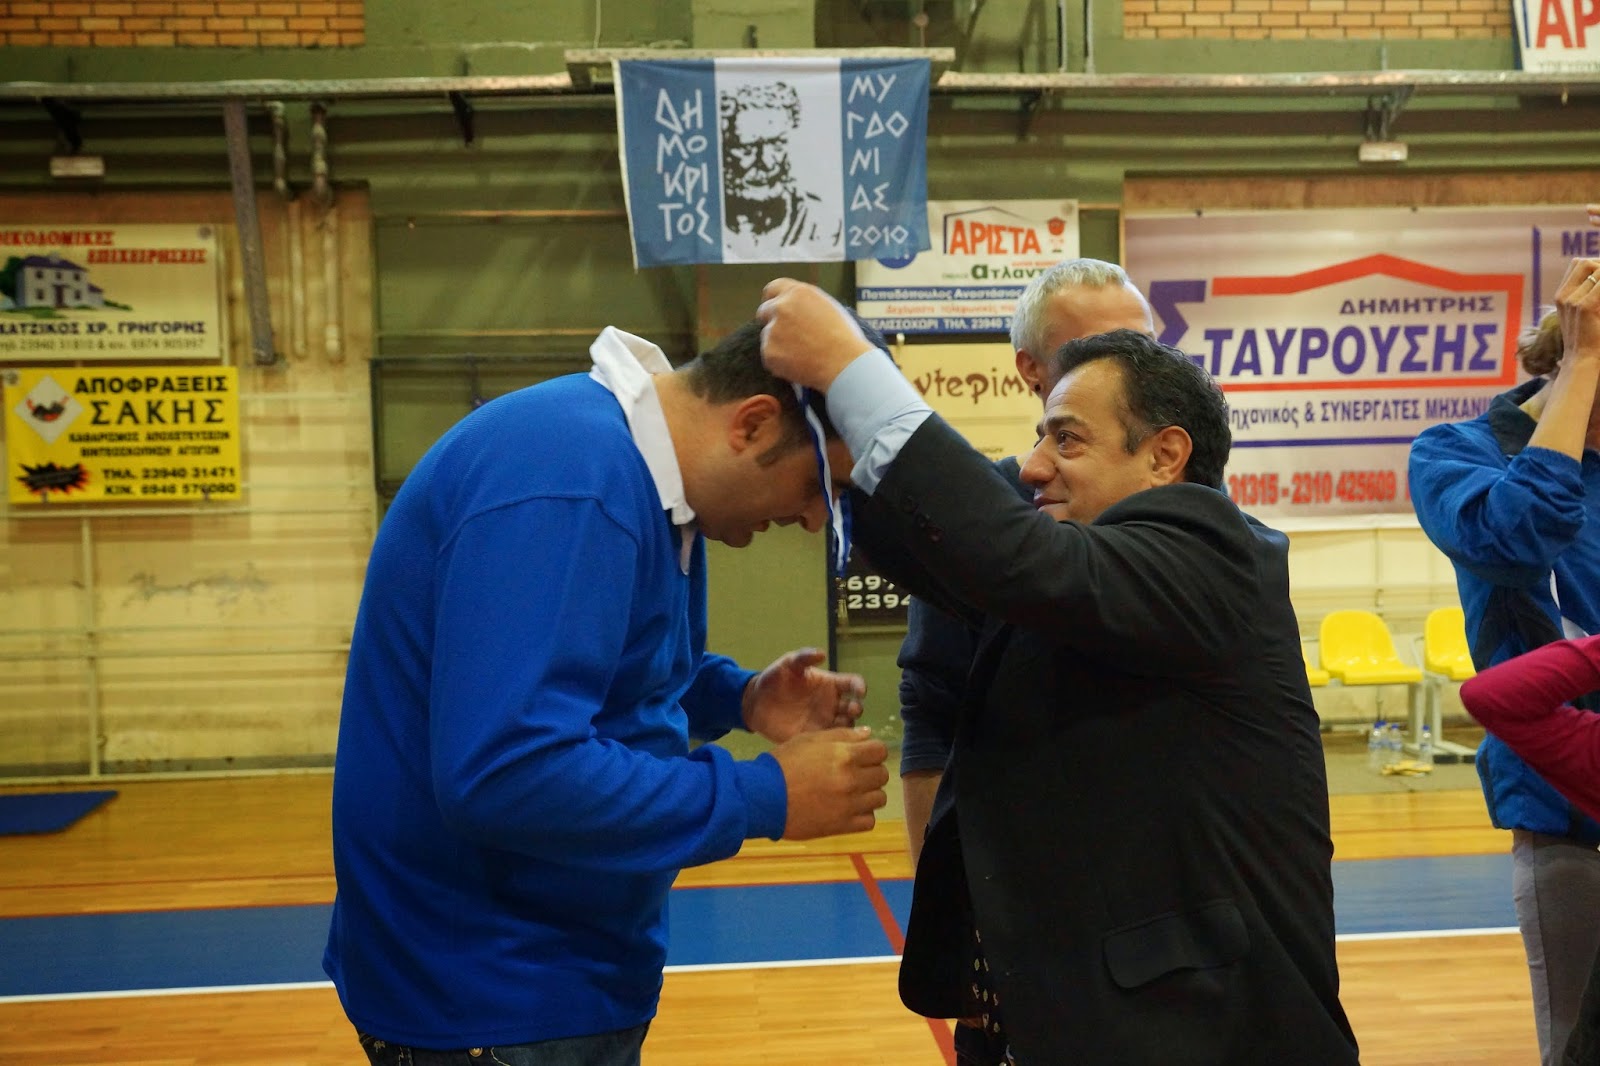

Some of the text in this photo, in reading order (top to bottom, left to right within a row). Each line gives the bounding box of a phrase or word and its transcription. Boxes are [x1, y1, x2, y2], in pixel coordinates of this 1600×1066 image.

[850, 225, 909, 247] 2010
[949, 218, 1042, 255] ΑΡΙΣΤΑ
[1339, 296, 1495, 314] ΔΗΜΗΤΡΗΣ
[117, 321, 205, 334] ΓΡΗΓΟΡΗΣ
[75, 376, 228, 393] ΑΠΟΦΡΑΞΕΙΣ
[90, 399, 224, 425] ΣΑΚΗΣ
[1228, 400, 1299, 430] ηχανικός
[1305, 402, 1315, 422] &
[1320, 398, 1421, 422] ΣΥΝΕΡΓΑΤΕΣ
[142, 468, 187, 479] 23940
[1291, 471, 1333, 504] 2310
